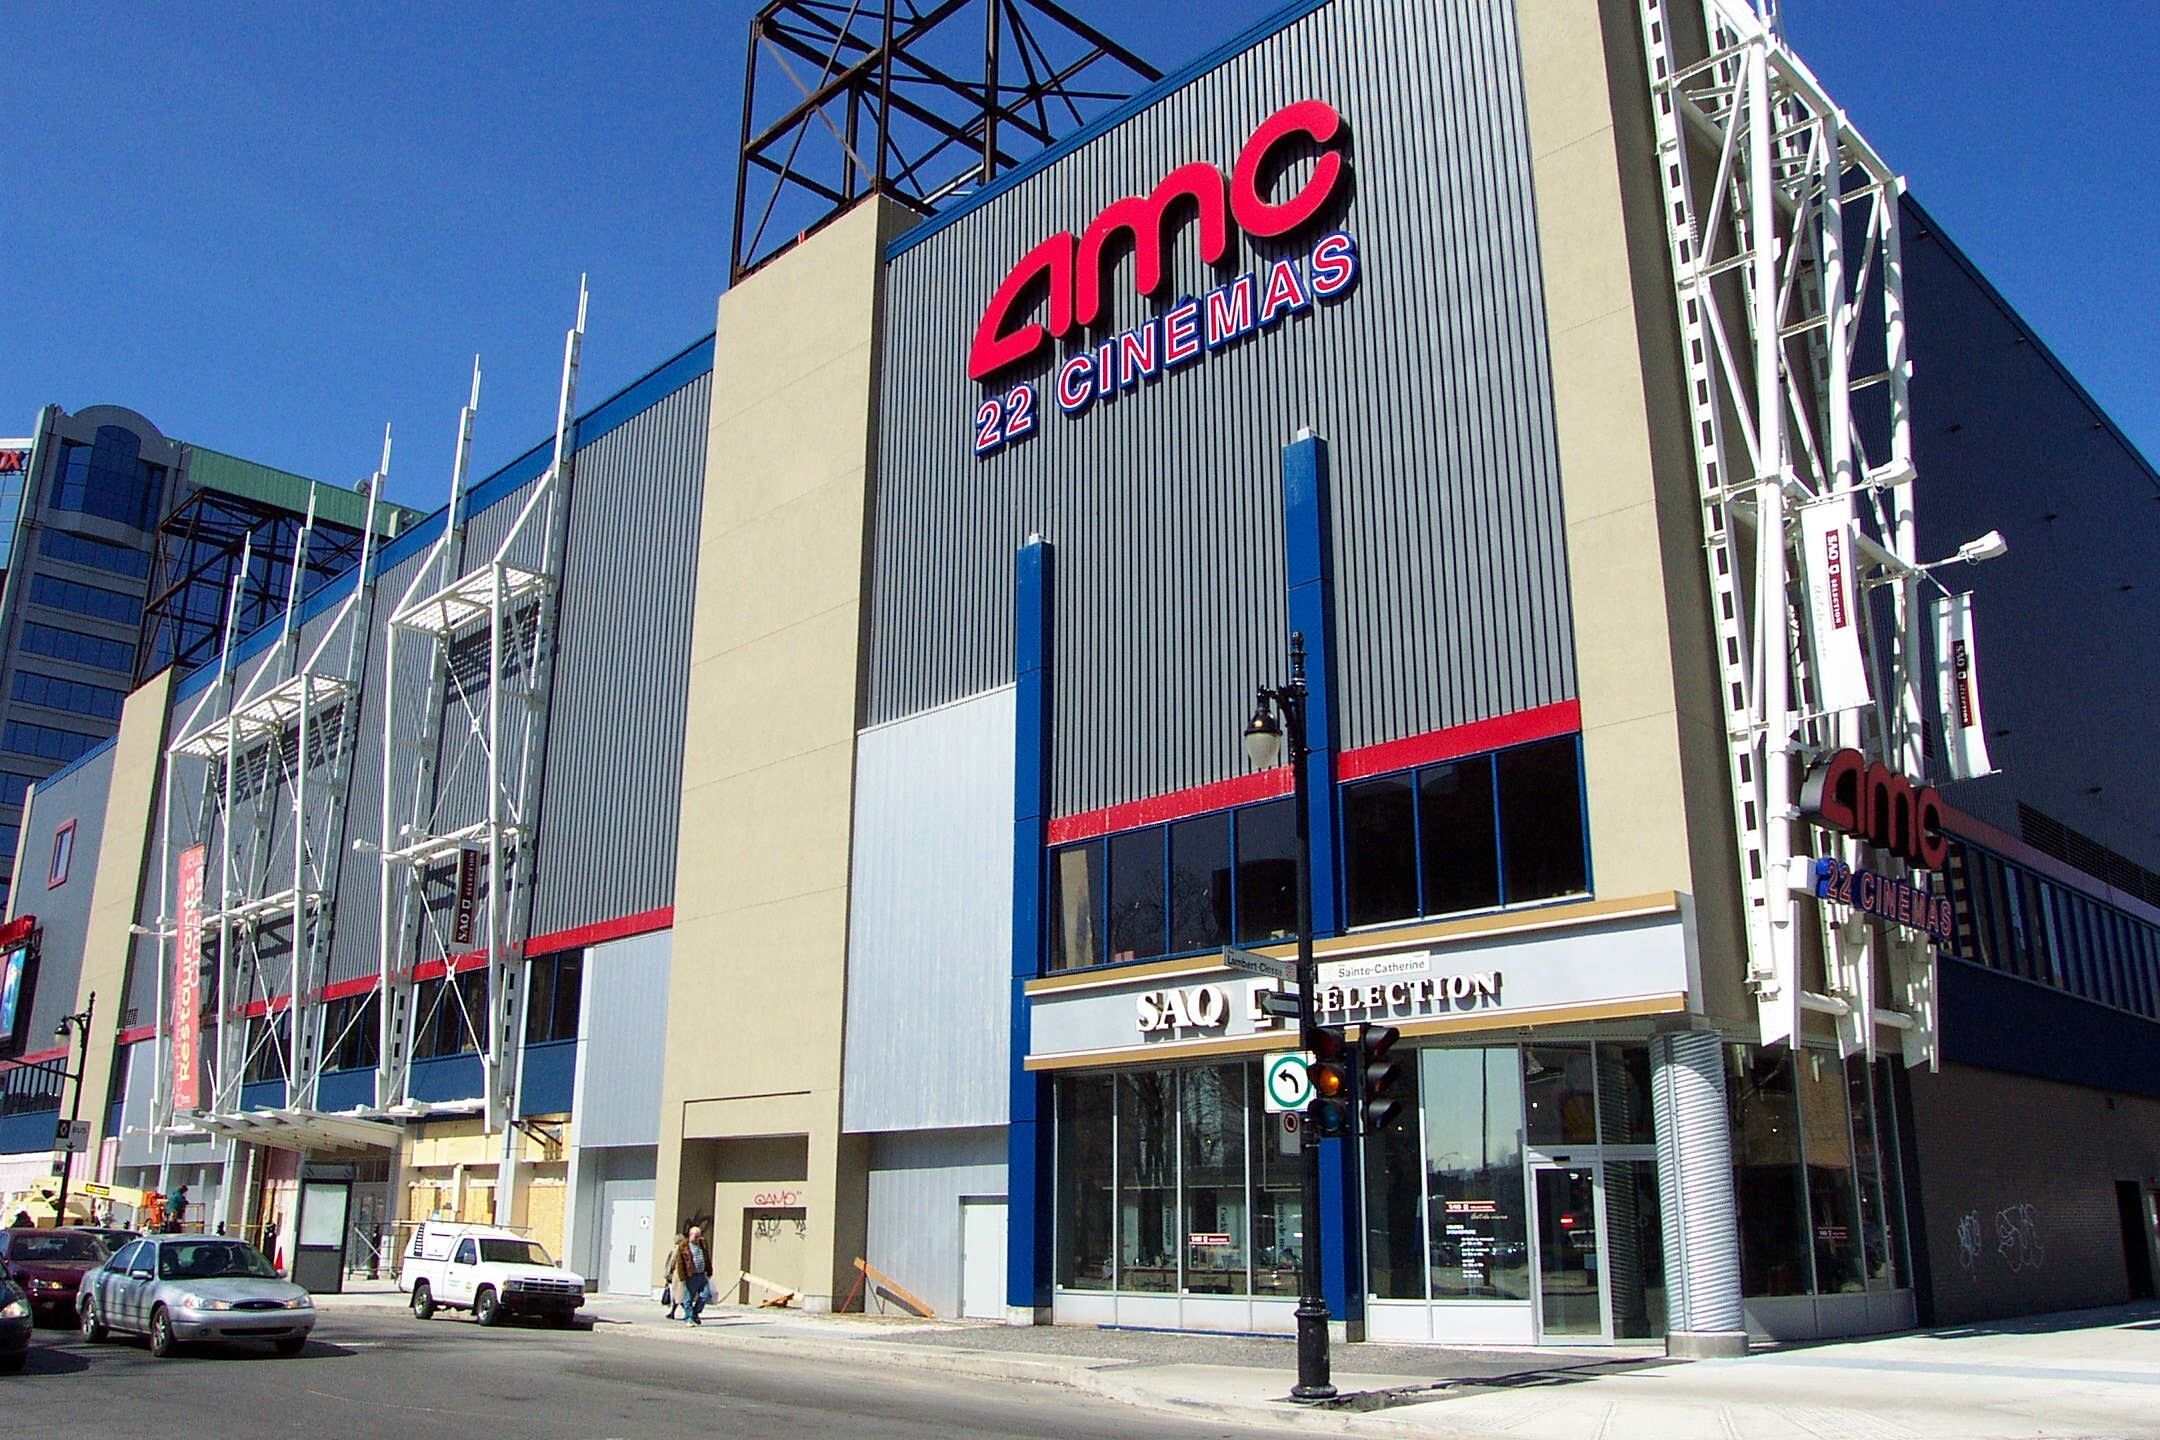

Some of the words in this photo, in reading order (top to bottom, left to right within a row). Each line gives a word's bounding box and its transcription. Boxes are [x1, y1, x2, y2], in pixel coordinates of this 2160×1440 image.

[975, 381, 1035, 454] 22
[1826, 534, 1839, 561] SAQ
[1955, 644, 1966, 667] SAQ
[1824, 857, 1852, 903] 22
[458, 914, 470, 941] SAQ
[180, 875, 195, 1081] Restaurants
[1338, 960, 1426, 979] Sainte-Catherine
[1136, 983, 1224, 1032] SAQ
